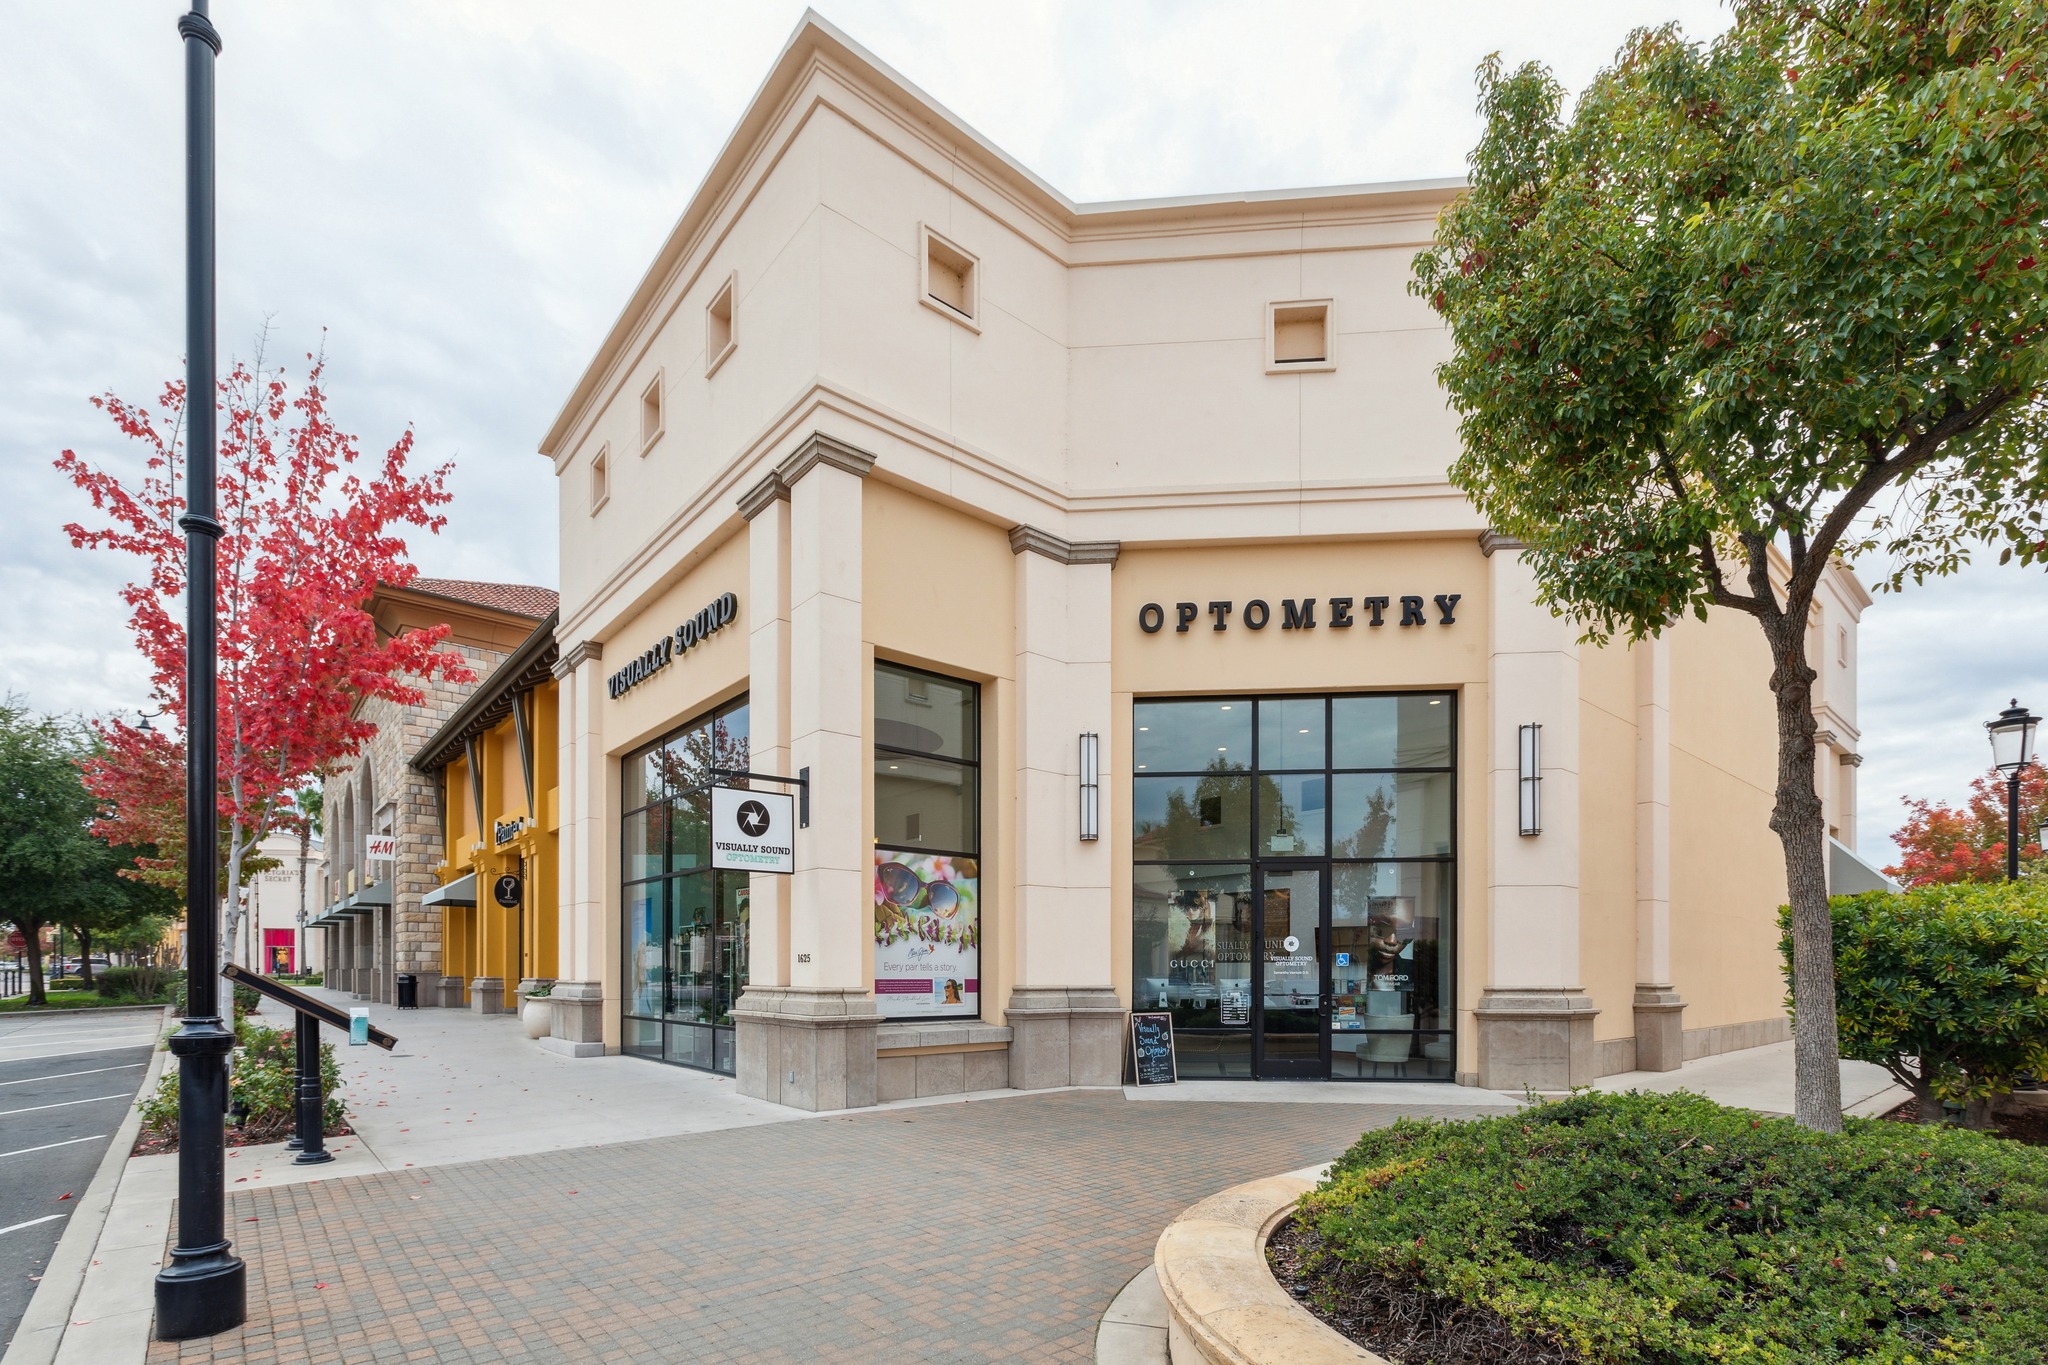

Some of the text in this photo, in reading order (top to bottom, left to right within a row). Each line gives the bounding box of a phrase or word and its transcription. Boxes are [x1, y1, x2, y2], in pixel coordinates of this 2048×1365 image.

[1139, 594, 1462, 634] OPTOMETRY
[607, 592, 738, 700] VISUALLY SOUND
[369, 840, 394, 855] H&M
[715, 842, 791, 855] VISUALLY SOUND
[726, 853, 781, 864] OPTOMETRY
[1216, 940, 1250, 950] SUALLY
[797, 953, 811, 963] 1625
[1169, 959, 1215, 969] GUCCI
[883, 961, 958, 973] Every pair tells a story.
